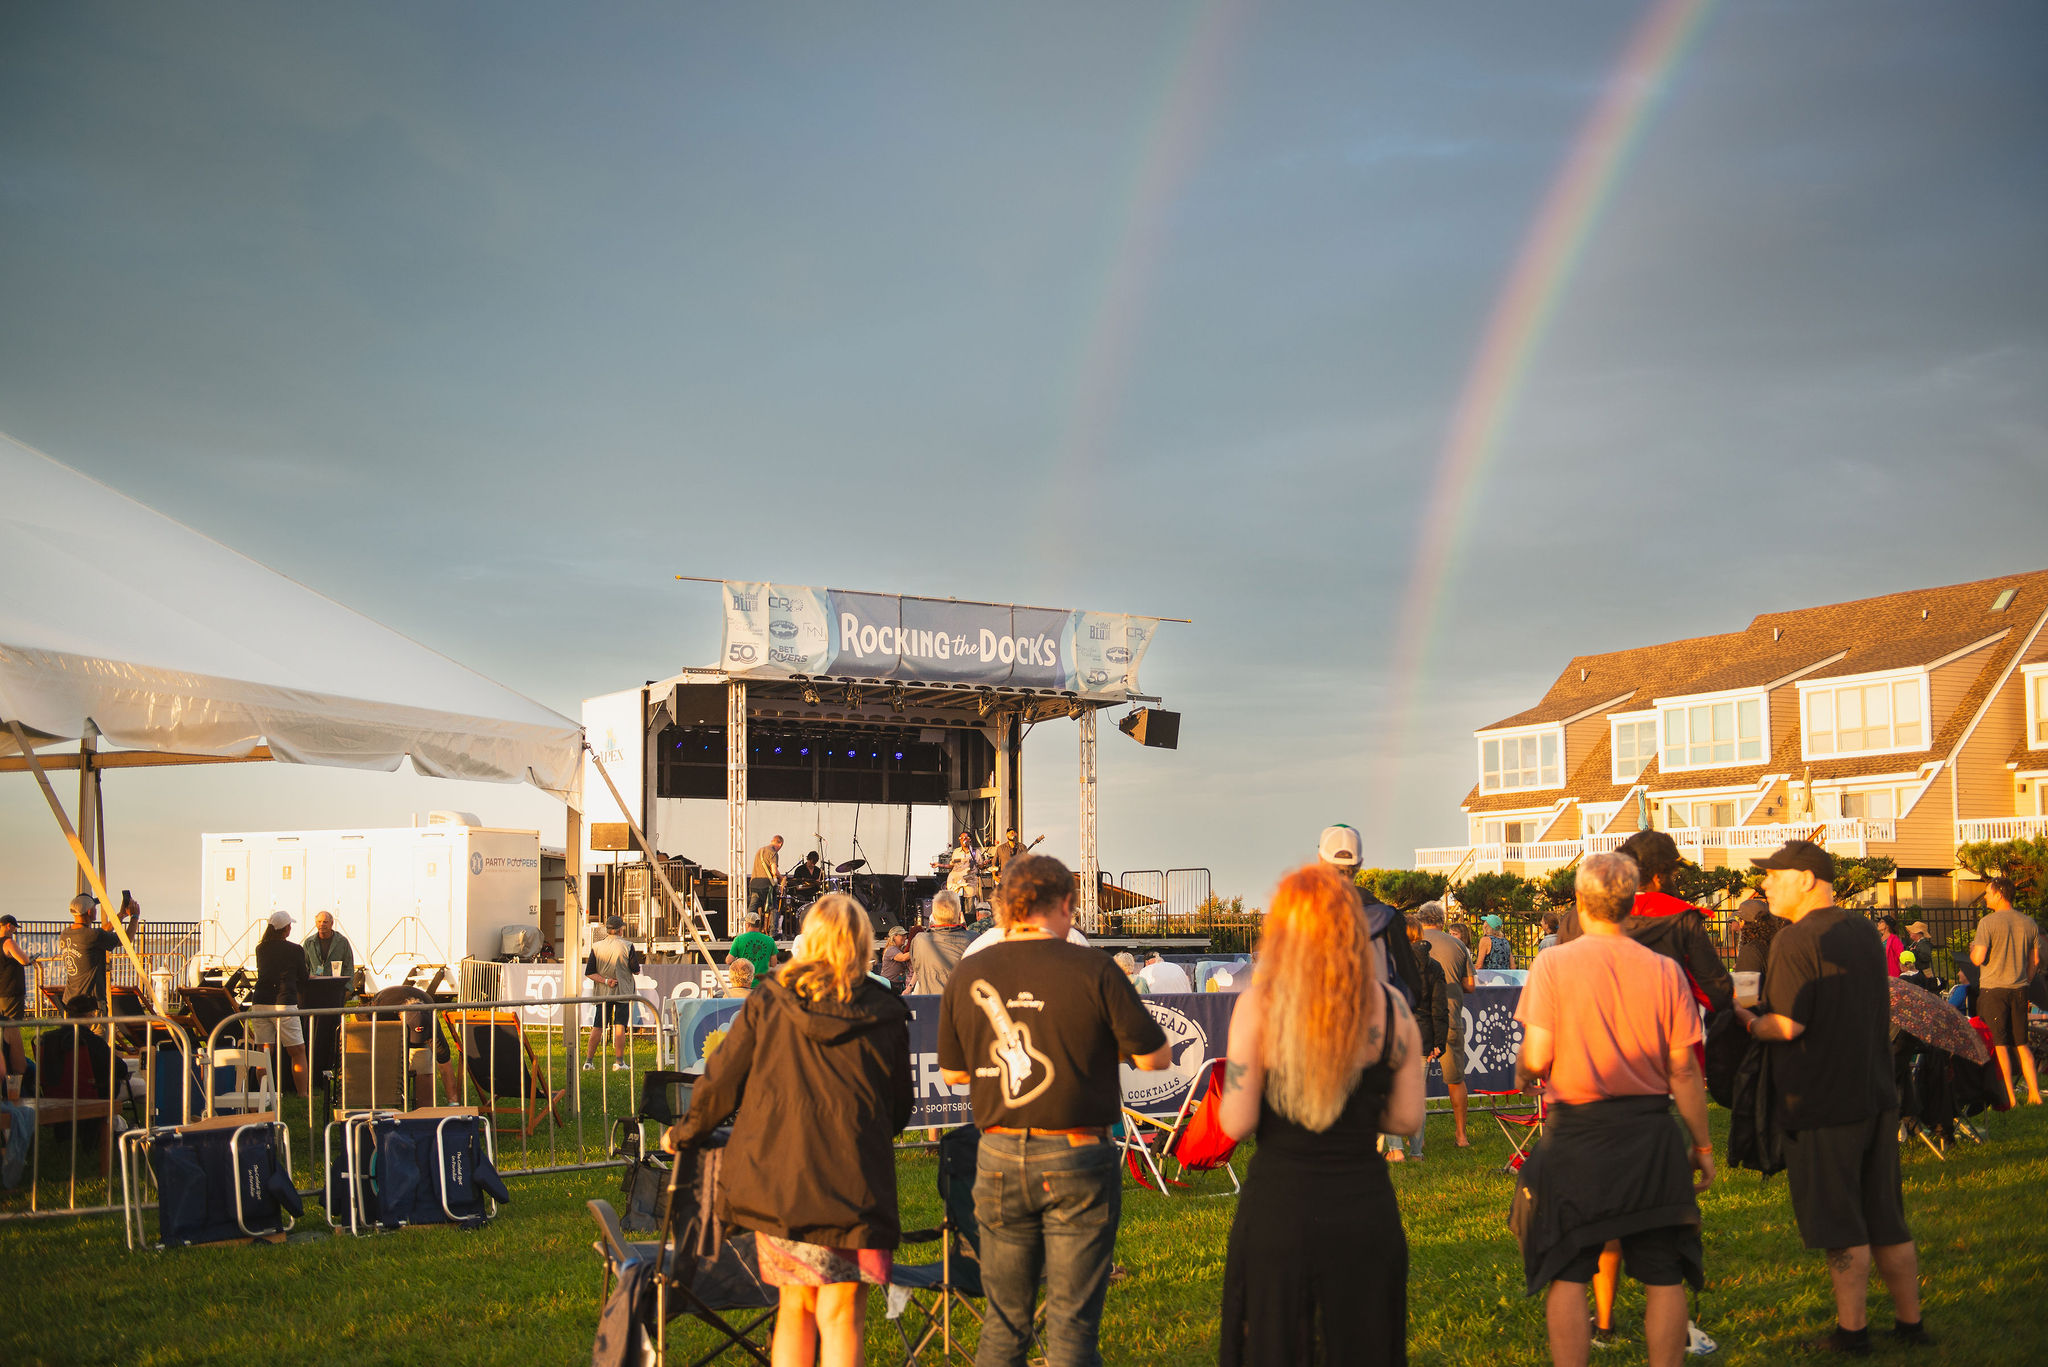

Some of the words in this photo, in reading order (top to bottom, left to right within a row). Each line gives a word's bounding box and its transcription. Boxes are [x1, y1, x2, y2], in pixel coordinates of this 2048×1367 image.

[841, 612, 950, 660] ROCKING
[950, 634, 980, 657] the
[979, 628, 1057, 667] DOCKS
[729, 644, 756, 661] 50
[768, 649, 808, 663] RIVERS
[778, 645, 794, 653] BET
[485, 857, 505, 867] PARTY
[506, 858, 538, 868] POOPERS
[700, 970, 733, 989] BE
[524, 975, 558, 1014] 50
[1127, 1077, 1180, 1100] COCKTAILS
